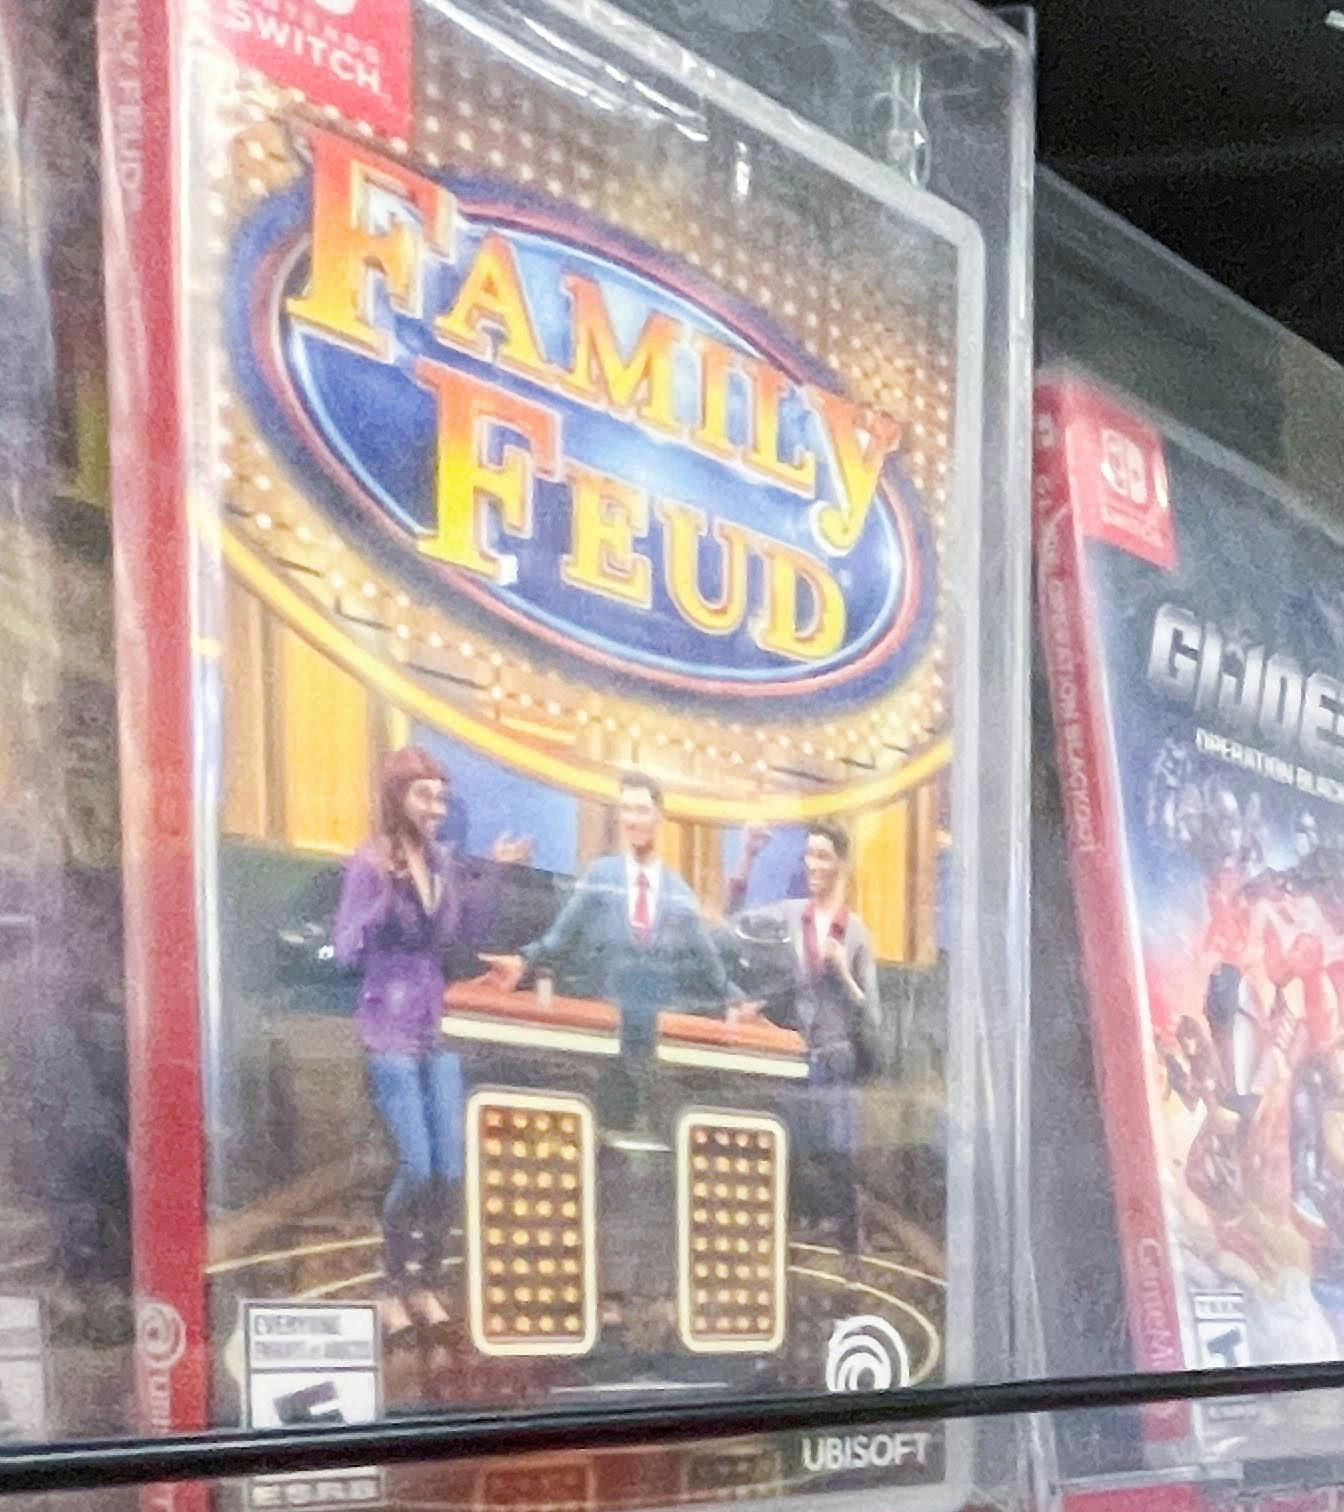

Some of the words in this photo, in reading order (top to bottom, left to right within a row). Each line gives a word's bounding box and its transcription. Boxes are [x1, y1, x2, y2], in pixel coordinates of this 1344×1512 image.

[216, 2, 384, 94] SWITCH
[288, 133, 902, 556] FAMILY
[418, 358, 846, 663] FEUD
[802, 1432, 931, 1472] UBISOFT
